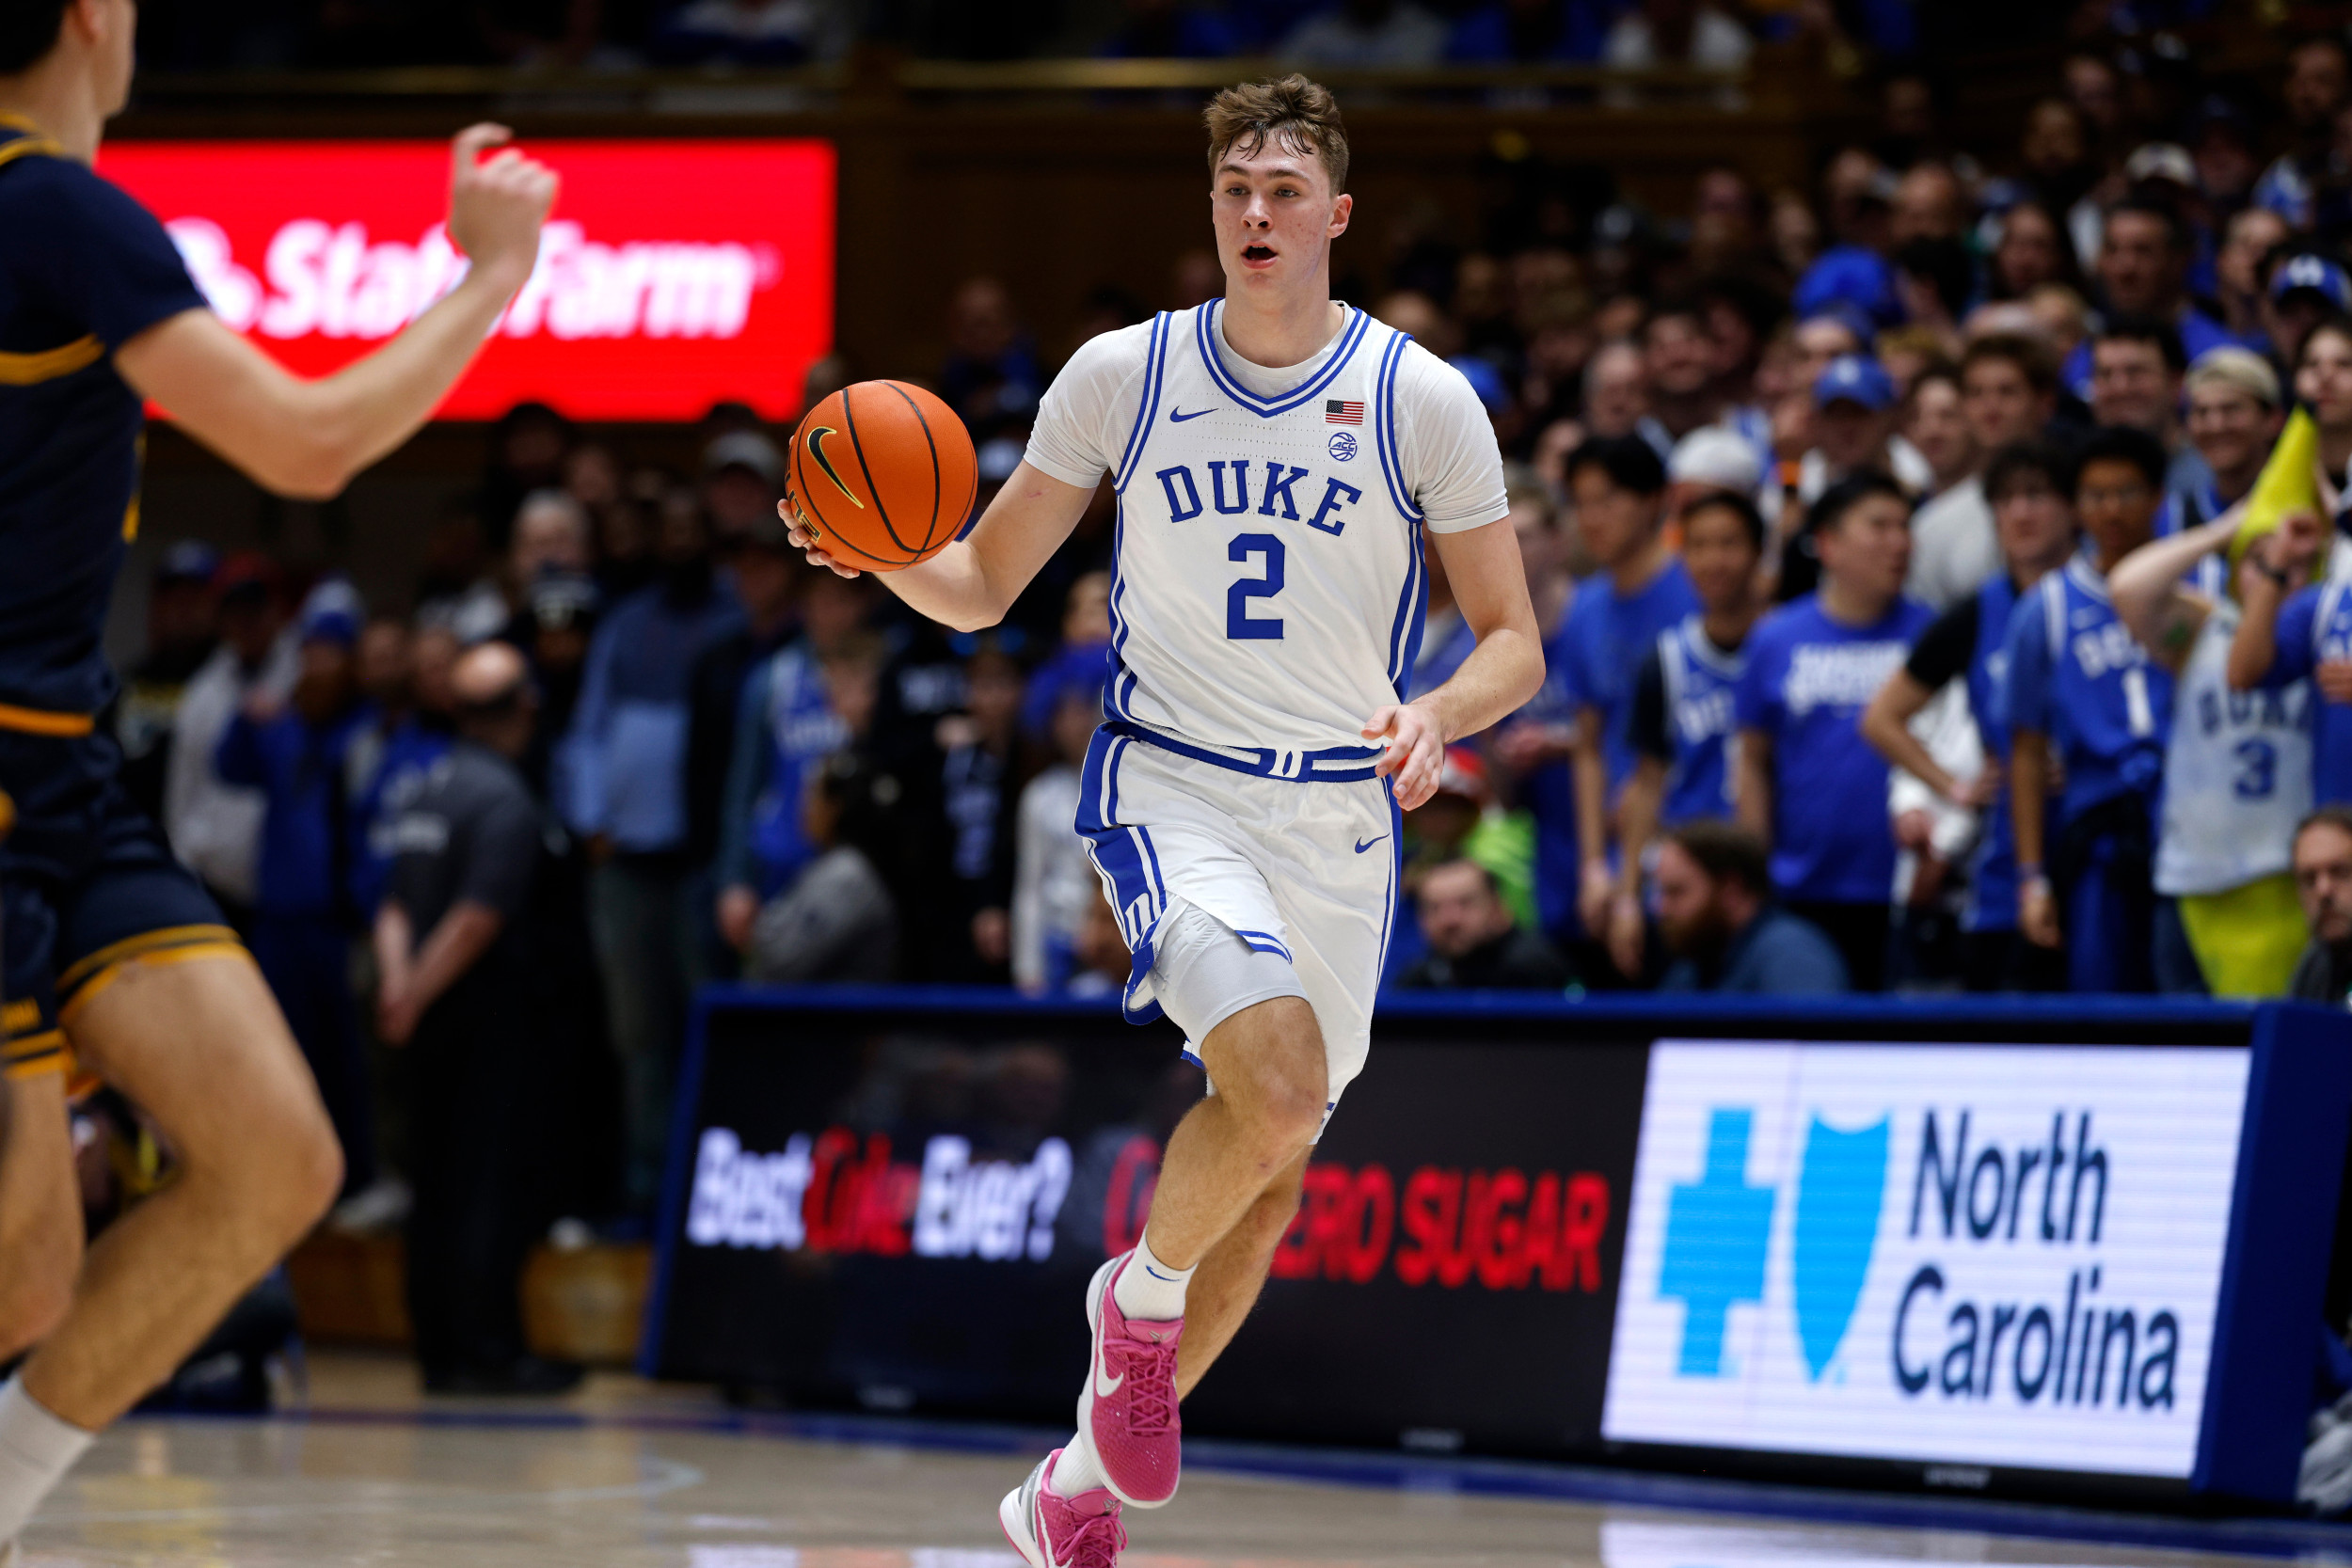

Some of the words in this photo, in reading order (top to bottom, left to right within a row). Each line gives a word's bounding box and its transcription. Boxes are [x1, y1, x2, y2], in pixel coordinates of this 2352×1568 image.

[258, 218, 470, 339] Stat
[499, 220, 753, 340] Farm
[1155, 460, 1362, 536] DUKE
[1226, 532, 1286, 640] 2
[2232, 736, 2279, 800] 3
[685, 1126, 815, 1251] Best
[910, 1133, 1074, 1261] Ever?
[1270, 1161, 1395, 1284] ERO
[1395, 1164, 1610, 1292] SUGAR
[1907, 1108, 2108, 1243] North
[1893, 1264, 2181, 1409] Carolina
